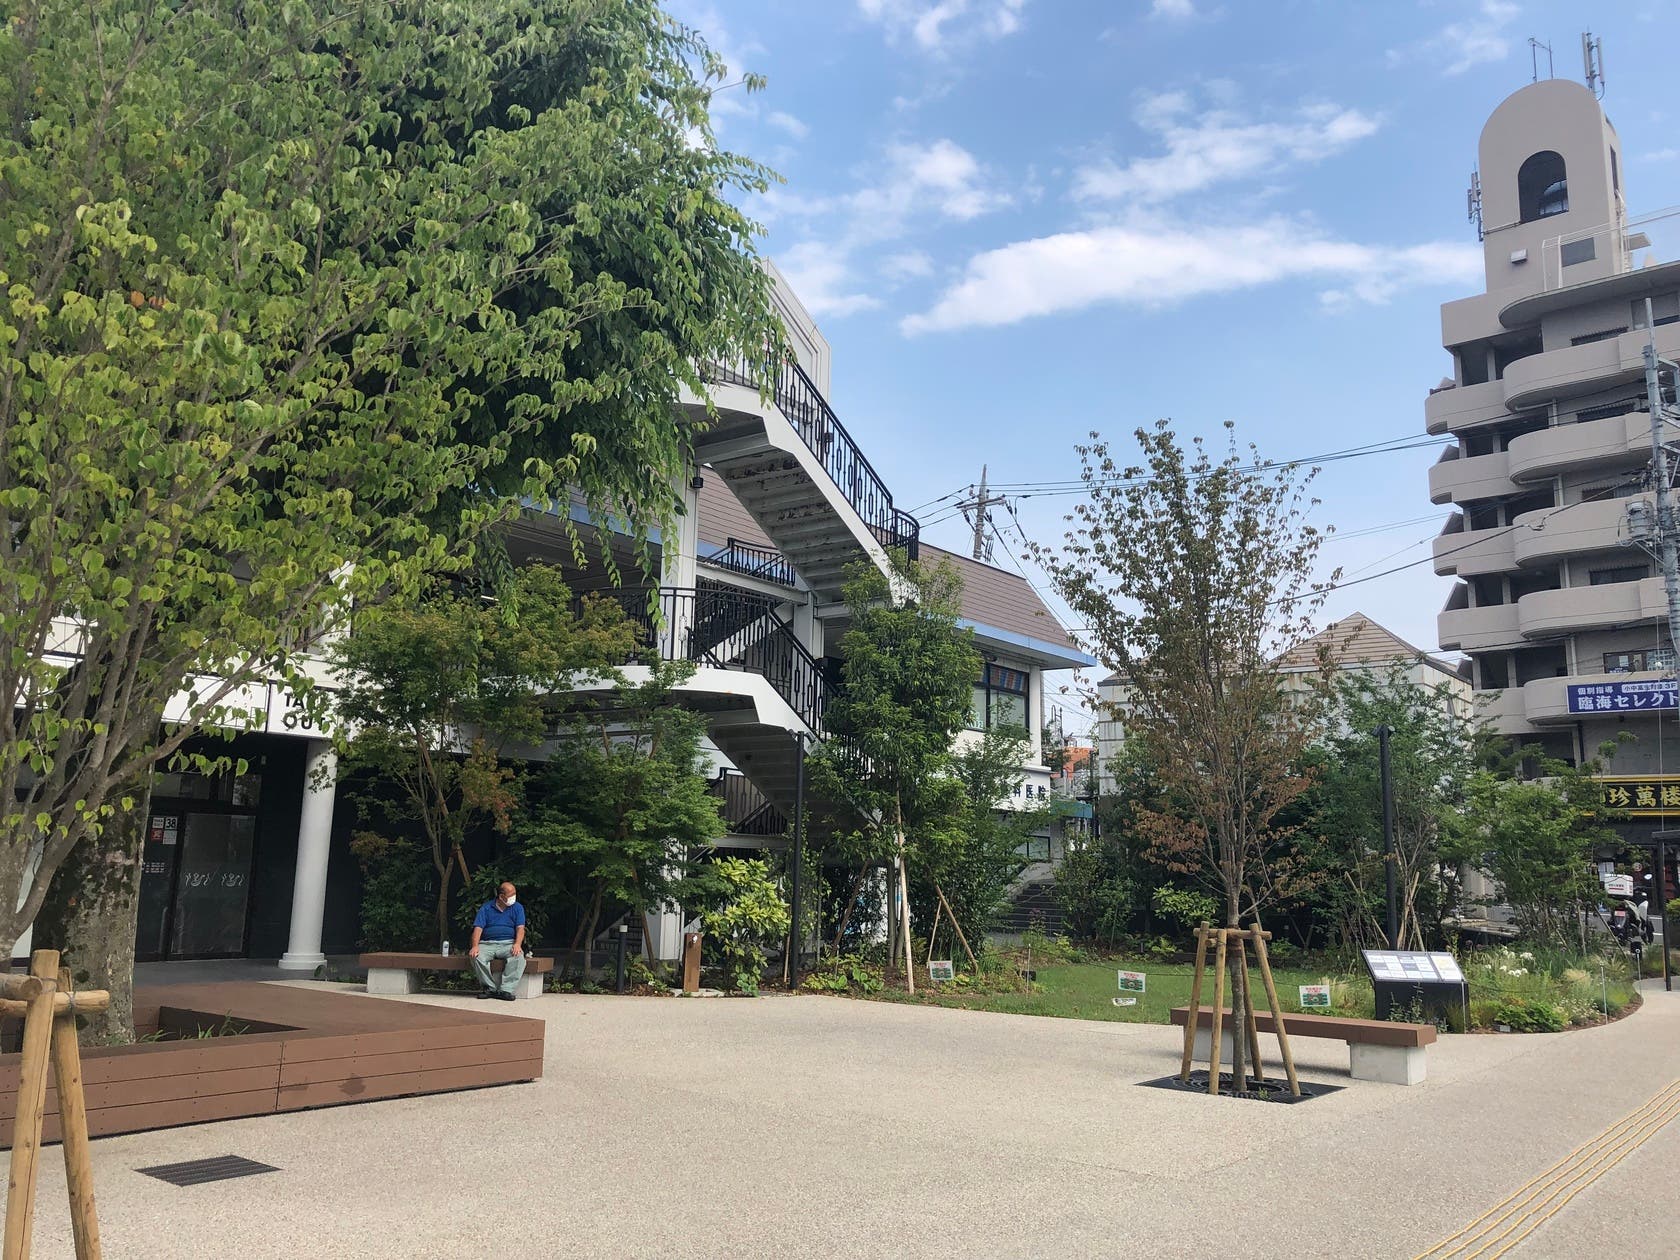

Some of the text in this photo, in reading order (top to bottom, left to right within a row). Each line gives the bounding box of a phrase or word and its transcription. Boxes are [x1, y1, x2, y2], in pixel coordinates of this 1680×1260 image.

[1577, 685, 1614, 695] 個別指導
[1577, 691, 1679, 710] 臨海セレクト
[166, 818, 176, 828] 38
